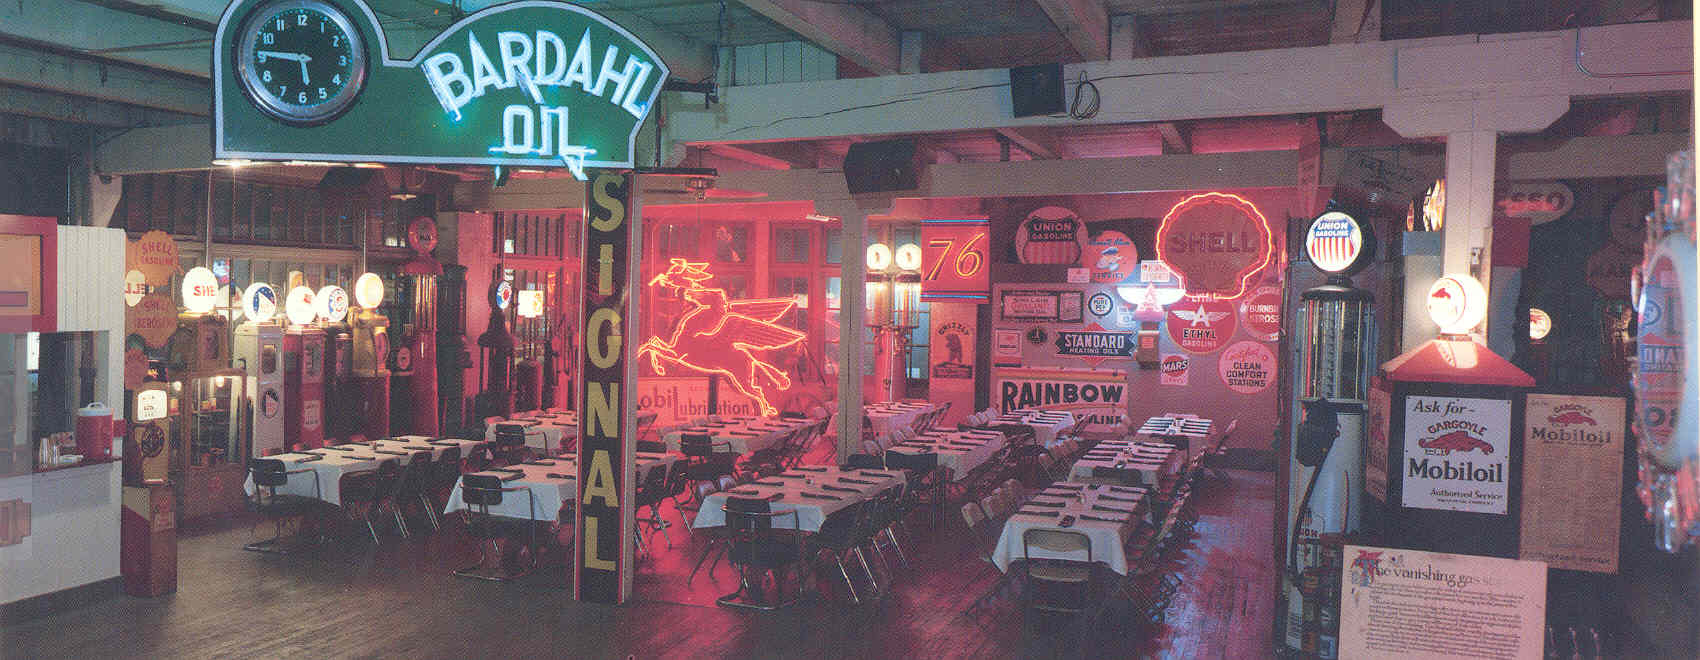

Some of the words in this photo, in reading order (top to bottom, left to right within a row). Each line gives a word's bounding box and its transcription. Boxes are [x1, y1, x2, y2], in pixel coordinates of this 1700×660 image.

[276, 20, 285, 31] 11
[297, 15, 308, 26] 12
[320, 22, 326, 32] 1
[263, 33, 274, 45] 10
[333, 36, 340, 47] 2
[339, 55, 347, 65] 3
[263, 71, 271, 83] 8
[332, 73, 340, 85] 4
[421, 28, 653, 121] BARDAHL
[279, 86, 286, 97] 7
[299, 92, 306, 103] 6
[318, 88, 327, 99] 5
[1033, 223, 1072, 231] UNION
[1317, 222, 1348, 230] UNION
[142, 241, 172, 255] SHELL
[1167, 232, 1255, 253] SHELL
[927, 233, 984, 280] 76
[1183, 329, 1216, 339] ETHYL
[1064, 334, 1124, 350] STANDARD
[1161, 360, 1189, 372] MARS
[1233, 363, 1261, 371] CLEAN
[583, 174, 625, 571] SIGNAL
[1226, 371, 1267, 380] COMFORT
[1228, 379, 1266, 388] STATIONS
[1001, 381, 1122, 415] RAINBOW
[1412, 399, 1440, 413] Ask
[1427, 419, 1487, 436] GARGOYLE
[1531, 426, 1611, 443] Mobiloil
[1408, 458, 1503, 483] Mobiloil
[1393, 564, 1457, 588] vanishing
[1459, 574, 1481, 588] gas
